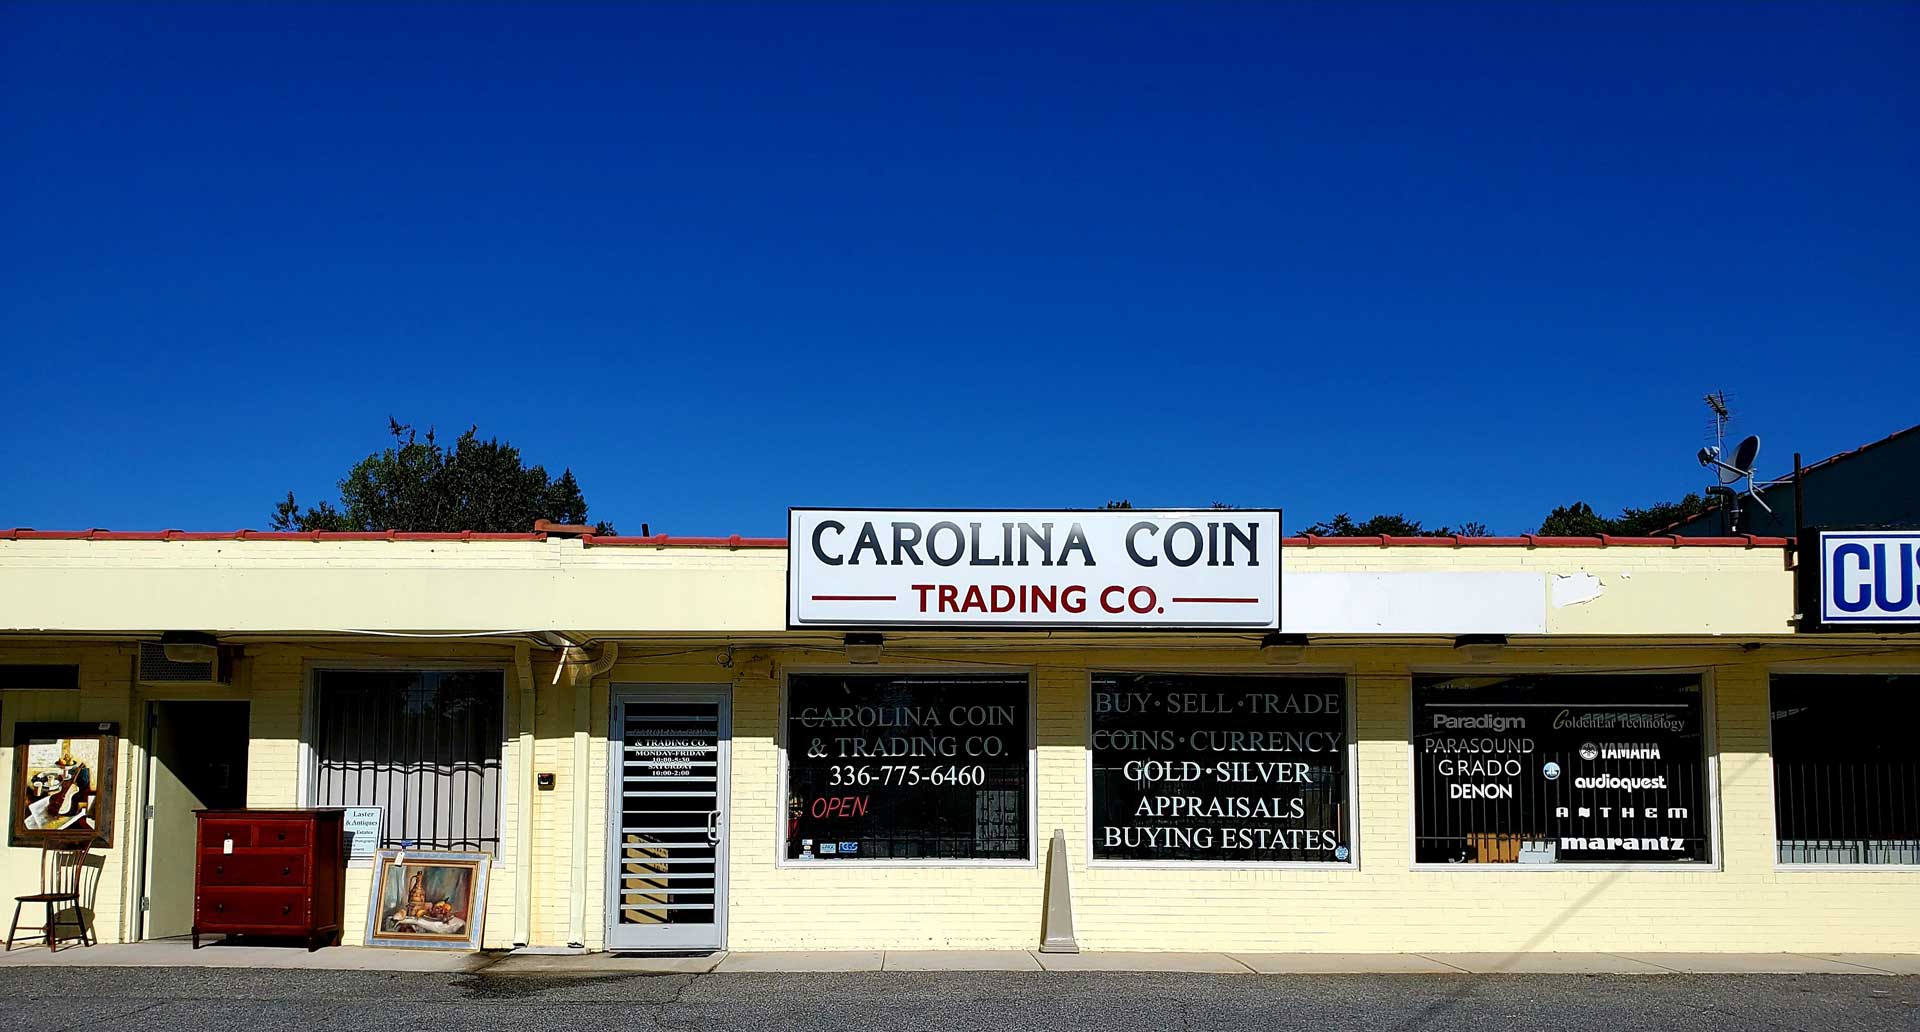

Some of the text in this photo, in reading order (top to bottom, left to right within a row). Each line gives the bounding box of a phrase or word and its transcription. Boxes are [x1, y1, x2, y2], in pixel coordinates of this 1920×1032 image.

[812, 520, 1259, 567] CAROLINA COIN
[1833, 543, 1920, 612] CU
[912, 584, 1164, 614] TRADING CO.
[1095, 693, 1340, 714] BUY SELL TRADE
[801, 706, 1015, 727] CAROLINA COIN
[1433, 713, 1526, 732] Paradigm
[807, 736, 1009, 758] & TRADING CO.
[1093, 730, 1343, 752] COINS CURRENCY
[1425, 738, 1535, 754] PARASOUND
[1599, 742, 1661, 759] YAMAHA
[830, 765, 985, 786] 336-775-6460
[1123, 760, 1313, 783] GOLD SILVER
[1438, 759, 1521, 776] GRADO
[1450, 783, 1513, 799] DENON
[1574, 773, 1667, 793] audioquest
[812, 796, 870, 818] OPEN
[1134, 796, 1305, 819] APPRAISALS
[1104, 826, 1337, 851] BUYING ESTATES
[1560, 836, 1685, 851] marantz
